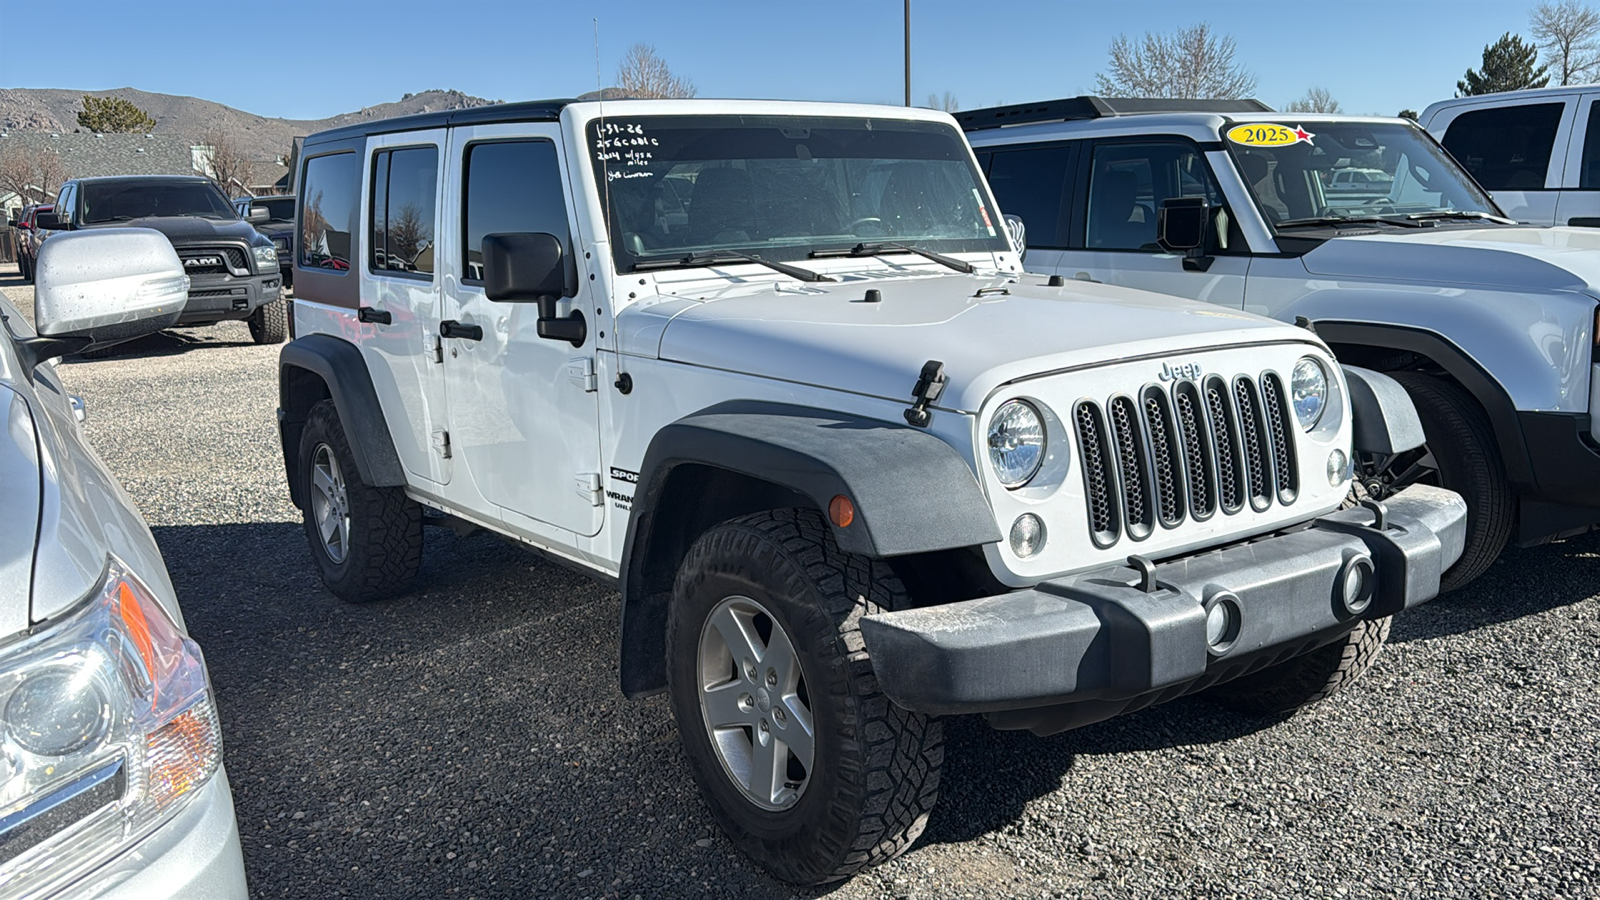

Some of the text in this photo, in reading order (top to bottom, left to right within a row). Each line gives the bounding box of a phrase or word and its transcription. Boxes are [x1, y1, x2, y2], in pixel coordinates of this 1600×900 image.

[1244, 128, 1289, 142] 2025
[597, 151, 621, 160] 2014
[184, 258, 217, 266] AM
[1158, 361, 1202, 382] Jeep
[611, 469, 640, 482] SPOR
[606, 490, 634, 503] WRAN
